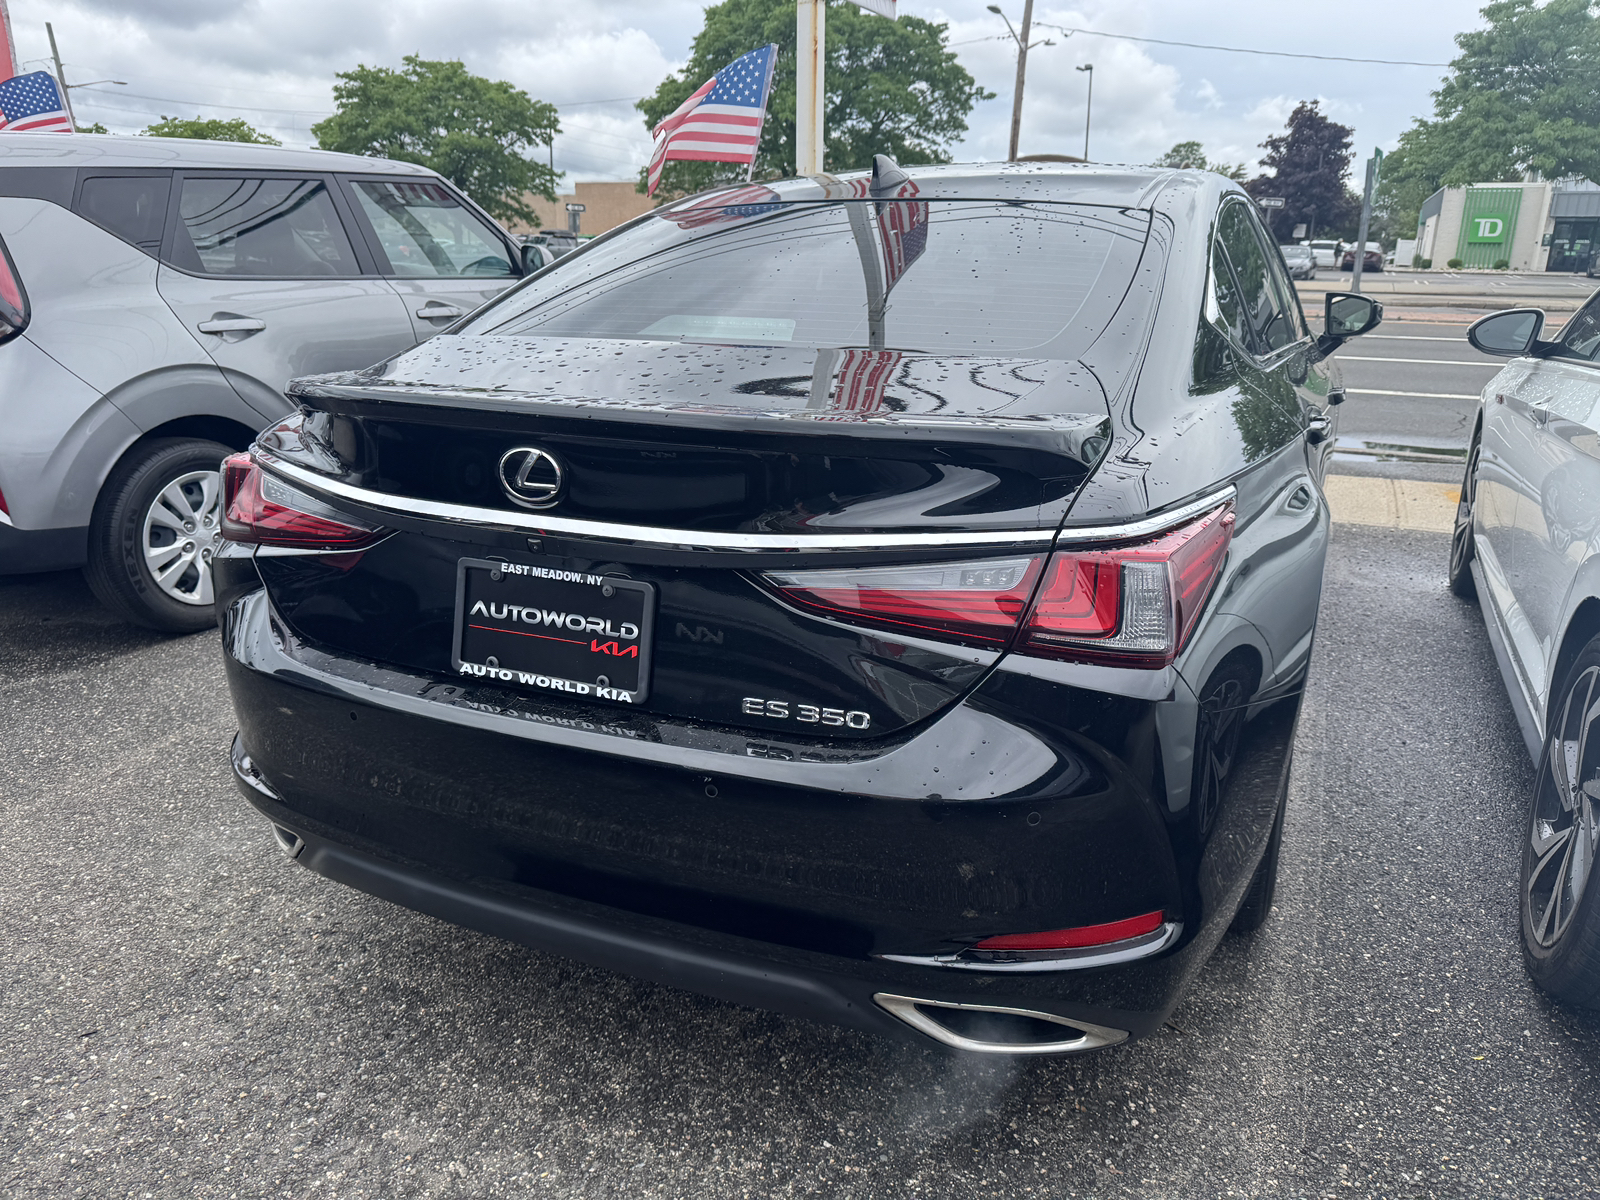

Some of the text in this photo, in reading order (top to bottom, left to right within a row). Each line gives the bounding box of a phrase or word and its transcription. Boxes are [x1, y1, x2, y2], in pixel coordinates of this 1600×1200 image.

[1474, 218, 1503, 237] TD
[122, 508, 147, 594] NEXEN
[501, 562, 530, 576] EAST
[587, 575, 603, 586] NY
[469, 600, 639, 640] AUTOWORLD
[590, 638, 639, 659] KIA
[459, 662, 633, 703] AUTO WORLD KIA
[741, 697, 872, 731] ES 350
